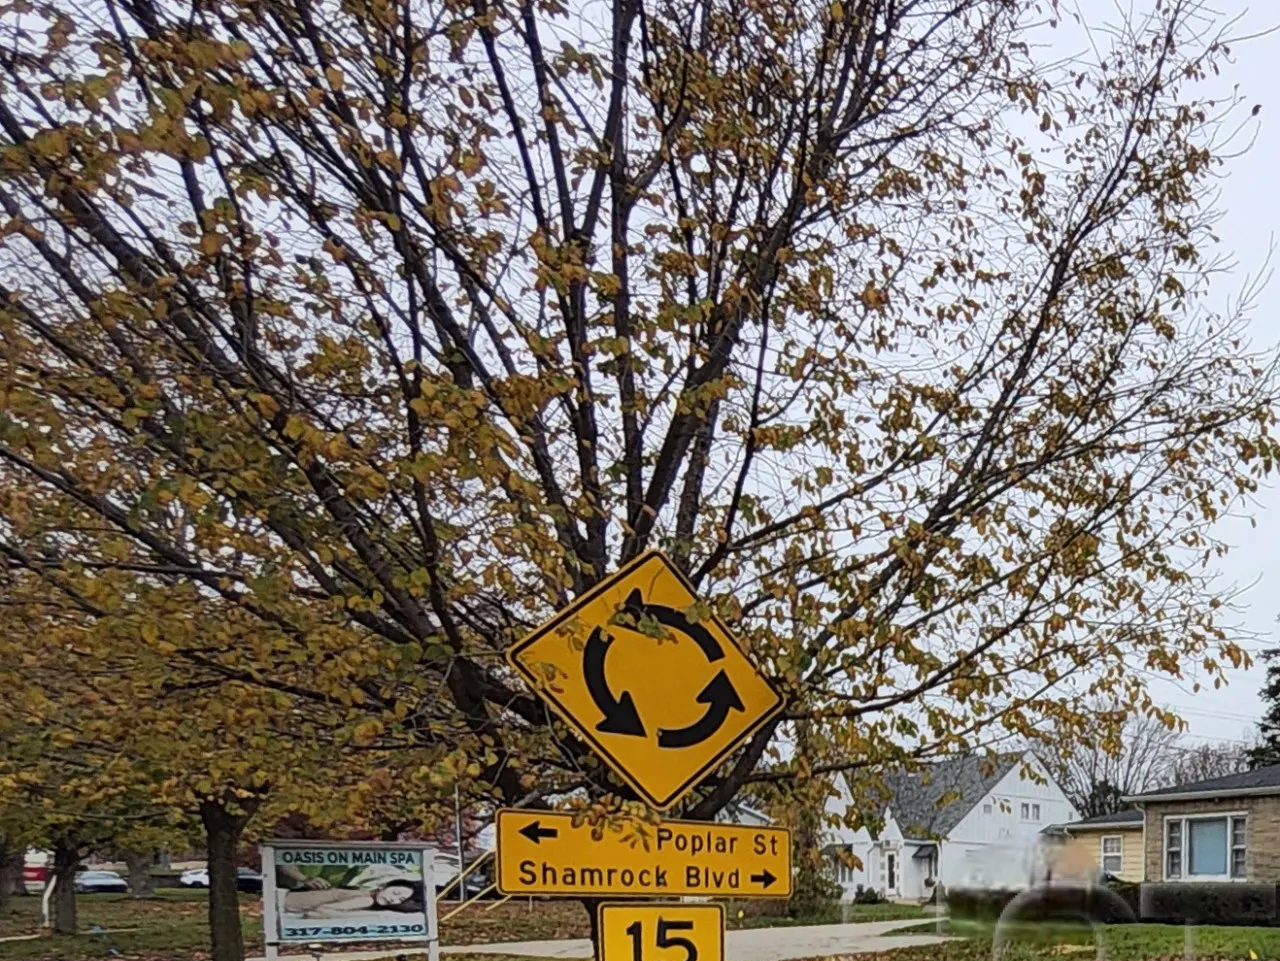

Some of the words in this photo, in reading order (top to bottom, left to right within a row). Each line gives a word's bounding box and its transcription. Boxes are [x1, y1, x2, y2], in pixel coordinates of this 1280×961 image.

[656, 828, 738, 855] Poplar
[753, 834, 778, 856] St
[282, 851, 325, 864] OASIS
[327, 852, 350, 864] ON
[352, 852, 387, 864] MAIN
[390, 851, 415, 864] SPA
[518, 860, 669, 887] Shamrock
[686, 865, 740, 889] Blvd
[285, 924, 422, 936] 317-804-2130
